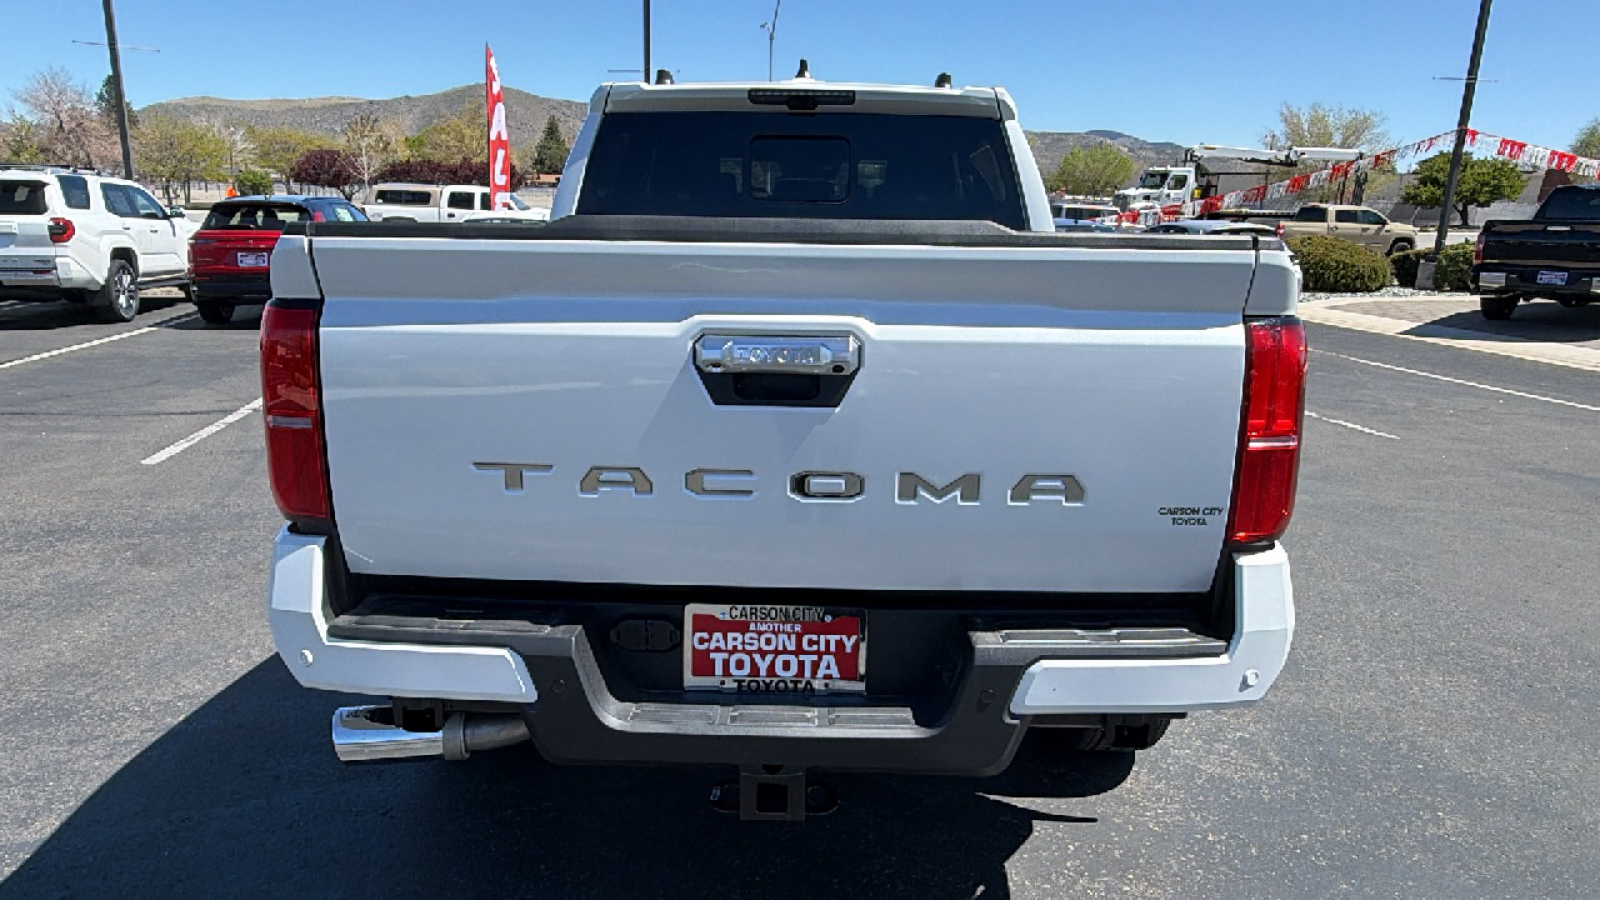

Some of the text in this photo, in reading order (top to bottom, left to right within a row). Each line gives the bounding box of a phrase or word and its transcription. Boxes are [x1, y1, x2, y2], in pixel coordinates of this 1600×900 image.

[736, 346, 815, 365] TOYOTA
[470, 461, 1087, 506] TACOMA
[1158, 506, 1224, 516] CARSON CITY
[1171, 517, 1208, 526] TOYOTA
[729, 605, 825, 622] CARSON CITY
[749, 622, 802, 632] ANOTHER
[693, 632, 858, 653] CARSON CITY
[709, 652, 841, 678] TOYOTA
[733, 679, 816, 693] TOYOTA
